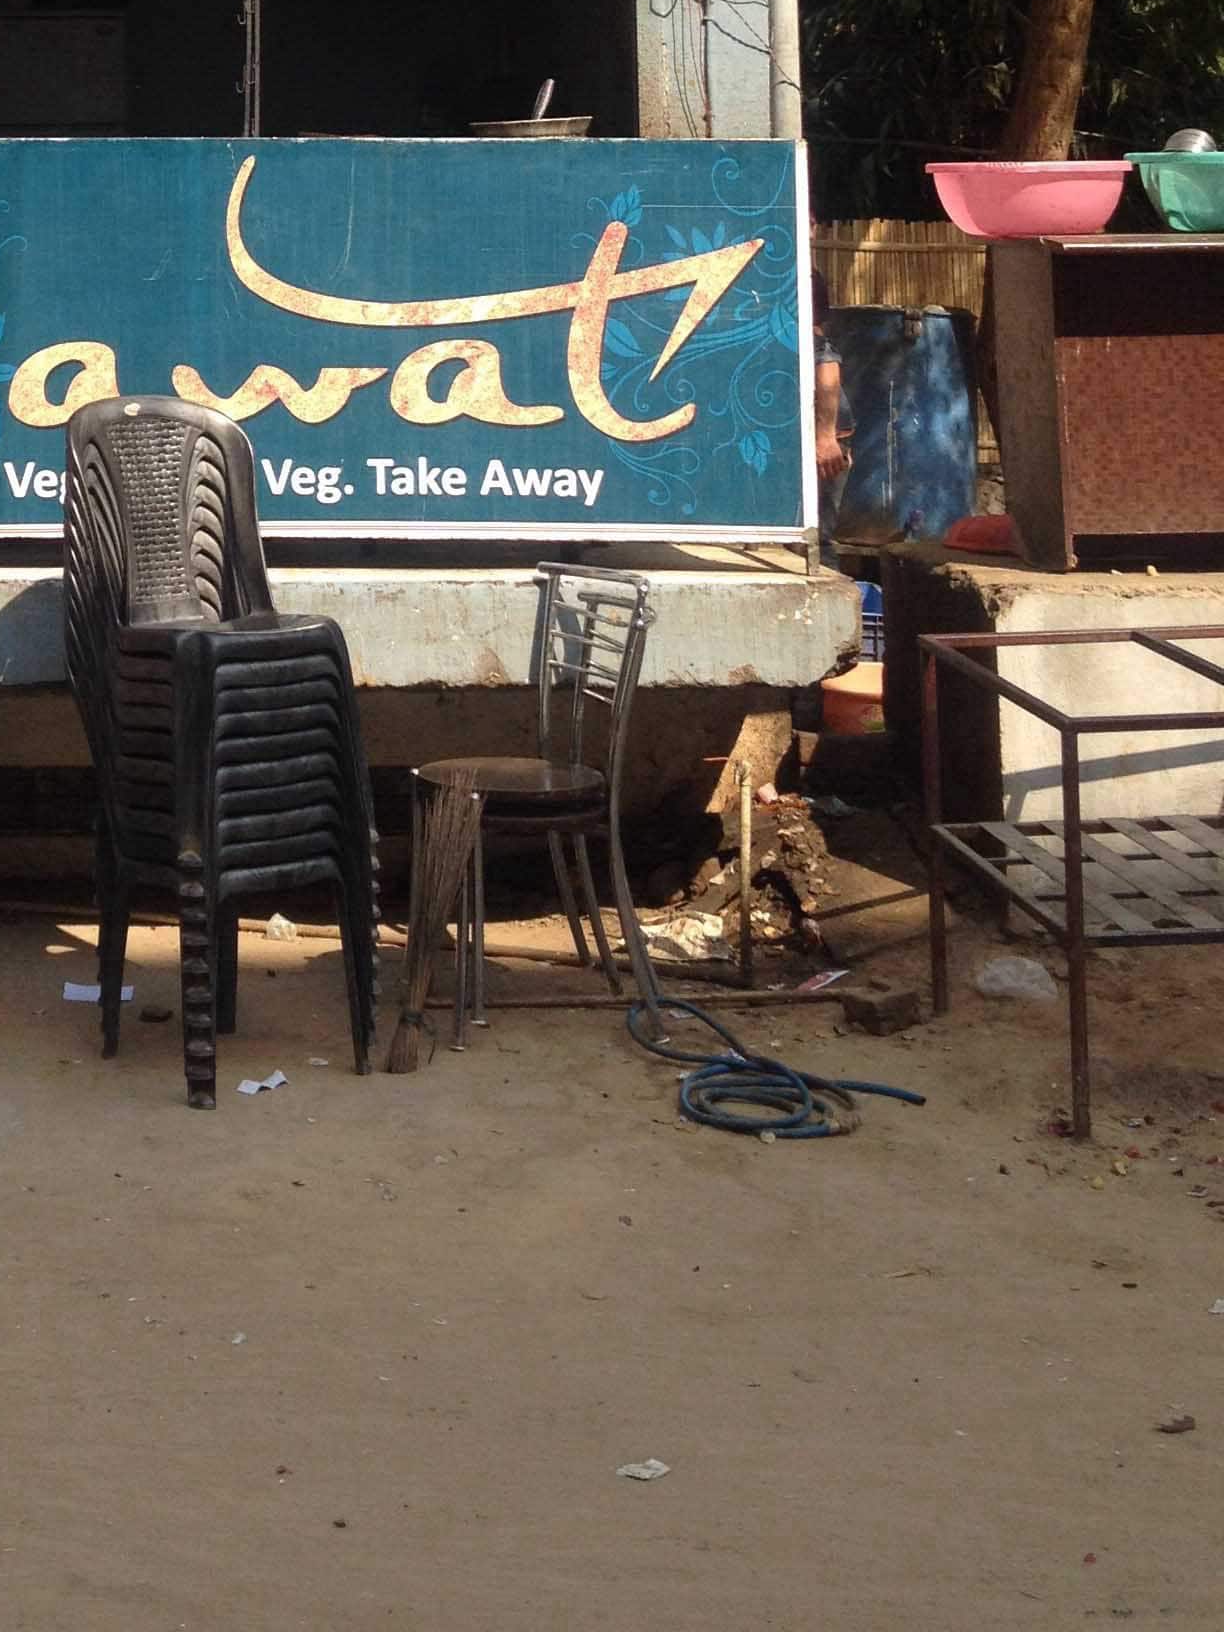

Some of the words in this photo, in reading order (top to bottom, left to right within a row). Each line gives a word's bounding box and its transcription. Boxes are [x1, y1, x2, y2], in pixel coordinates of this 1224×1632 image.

[260, 458, 354, 504] Veg.
[366, 456, 468, 496] Take
[479, 459, 605, 507] Away
